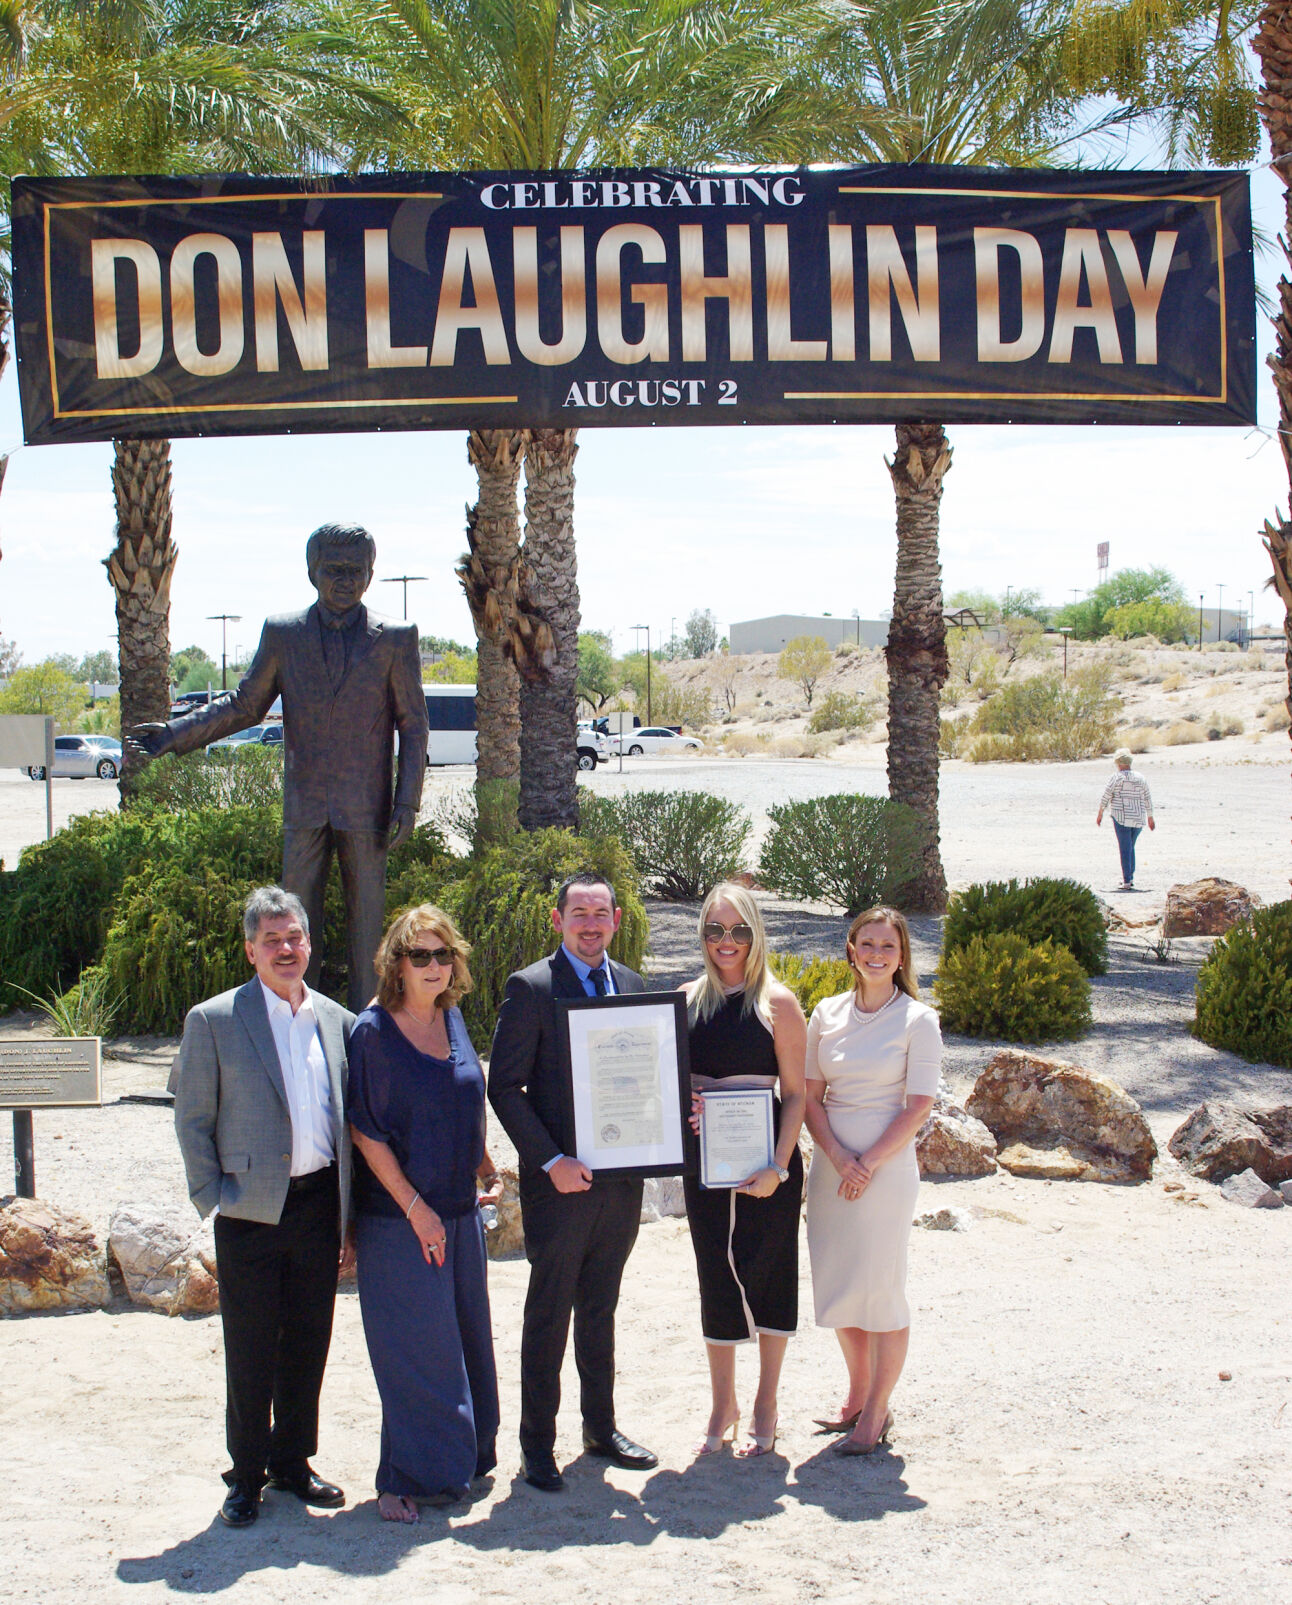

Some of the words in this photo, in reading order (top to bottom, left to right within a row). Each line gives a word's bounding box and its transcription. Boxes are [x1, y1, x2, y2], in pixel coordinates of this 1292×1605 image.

[480, 177, 806, 210] CELEBRATING
[91, 230, 329, 380] DON
[363, 223, 941, 369] LAUGHLIN
[974, 226, 1179, 366] DAY
[562, 380, 706, 407] AUGUST
[718, 380, 738, 405] 2
